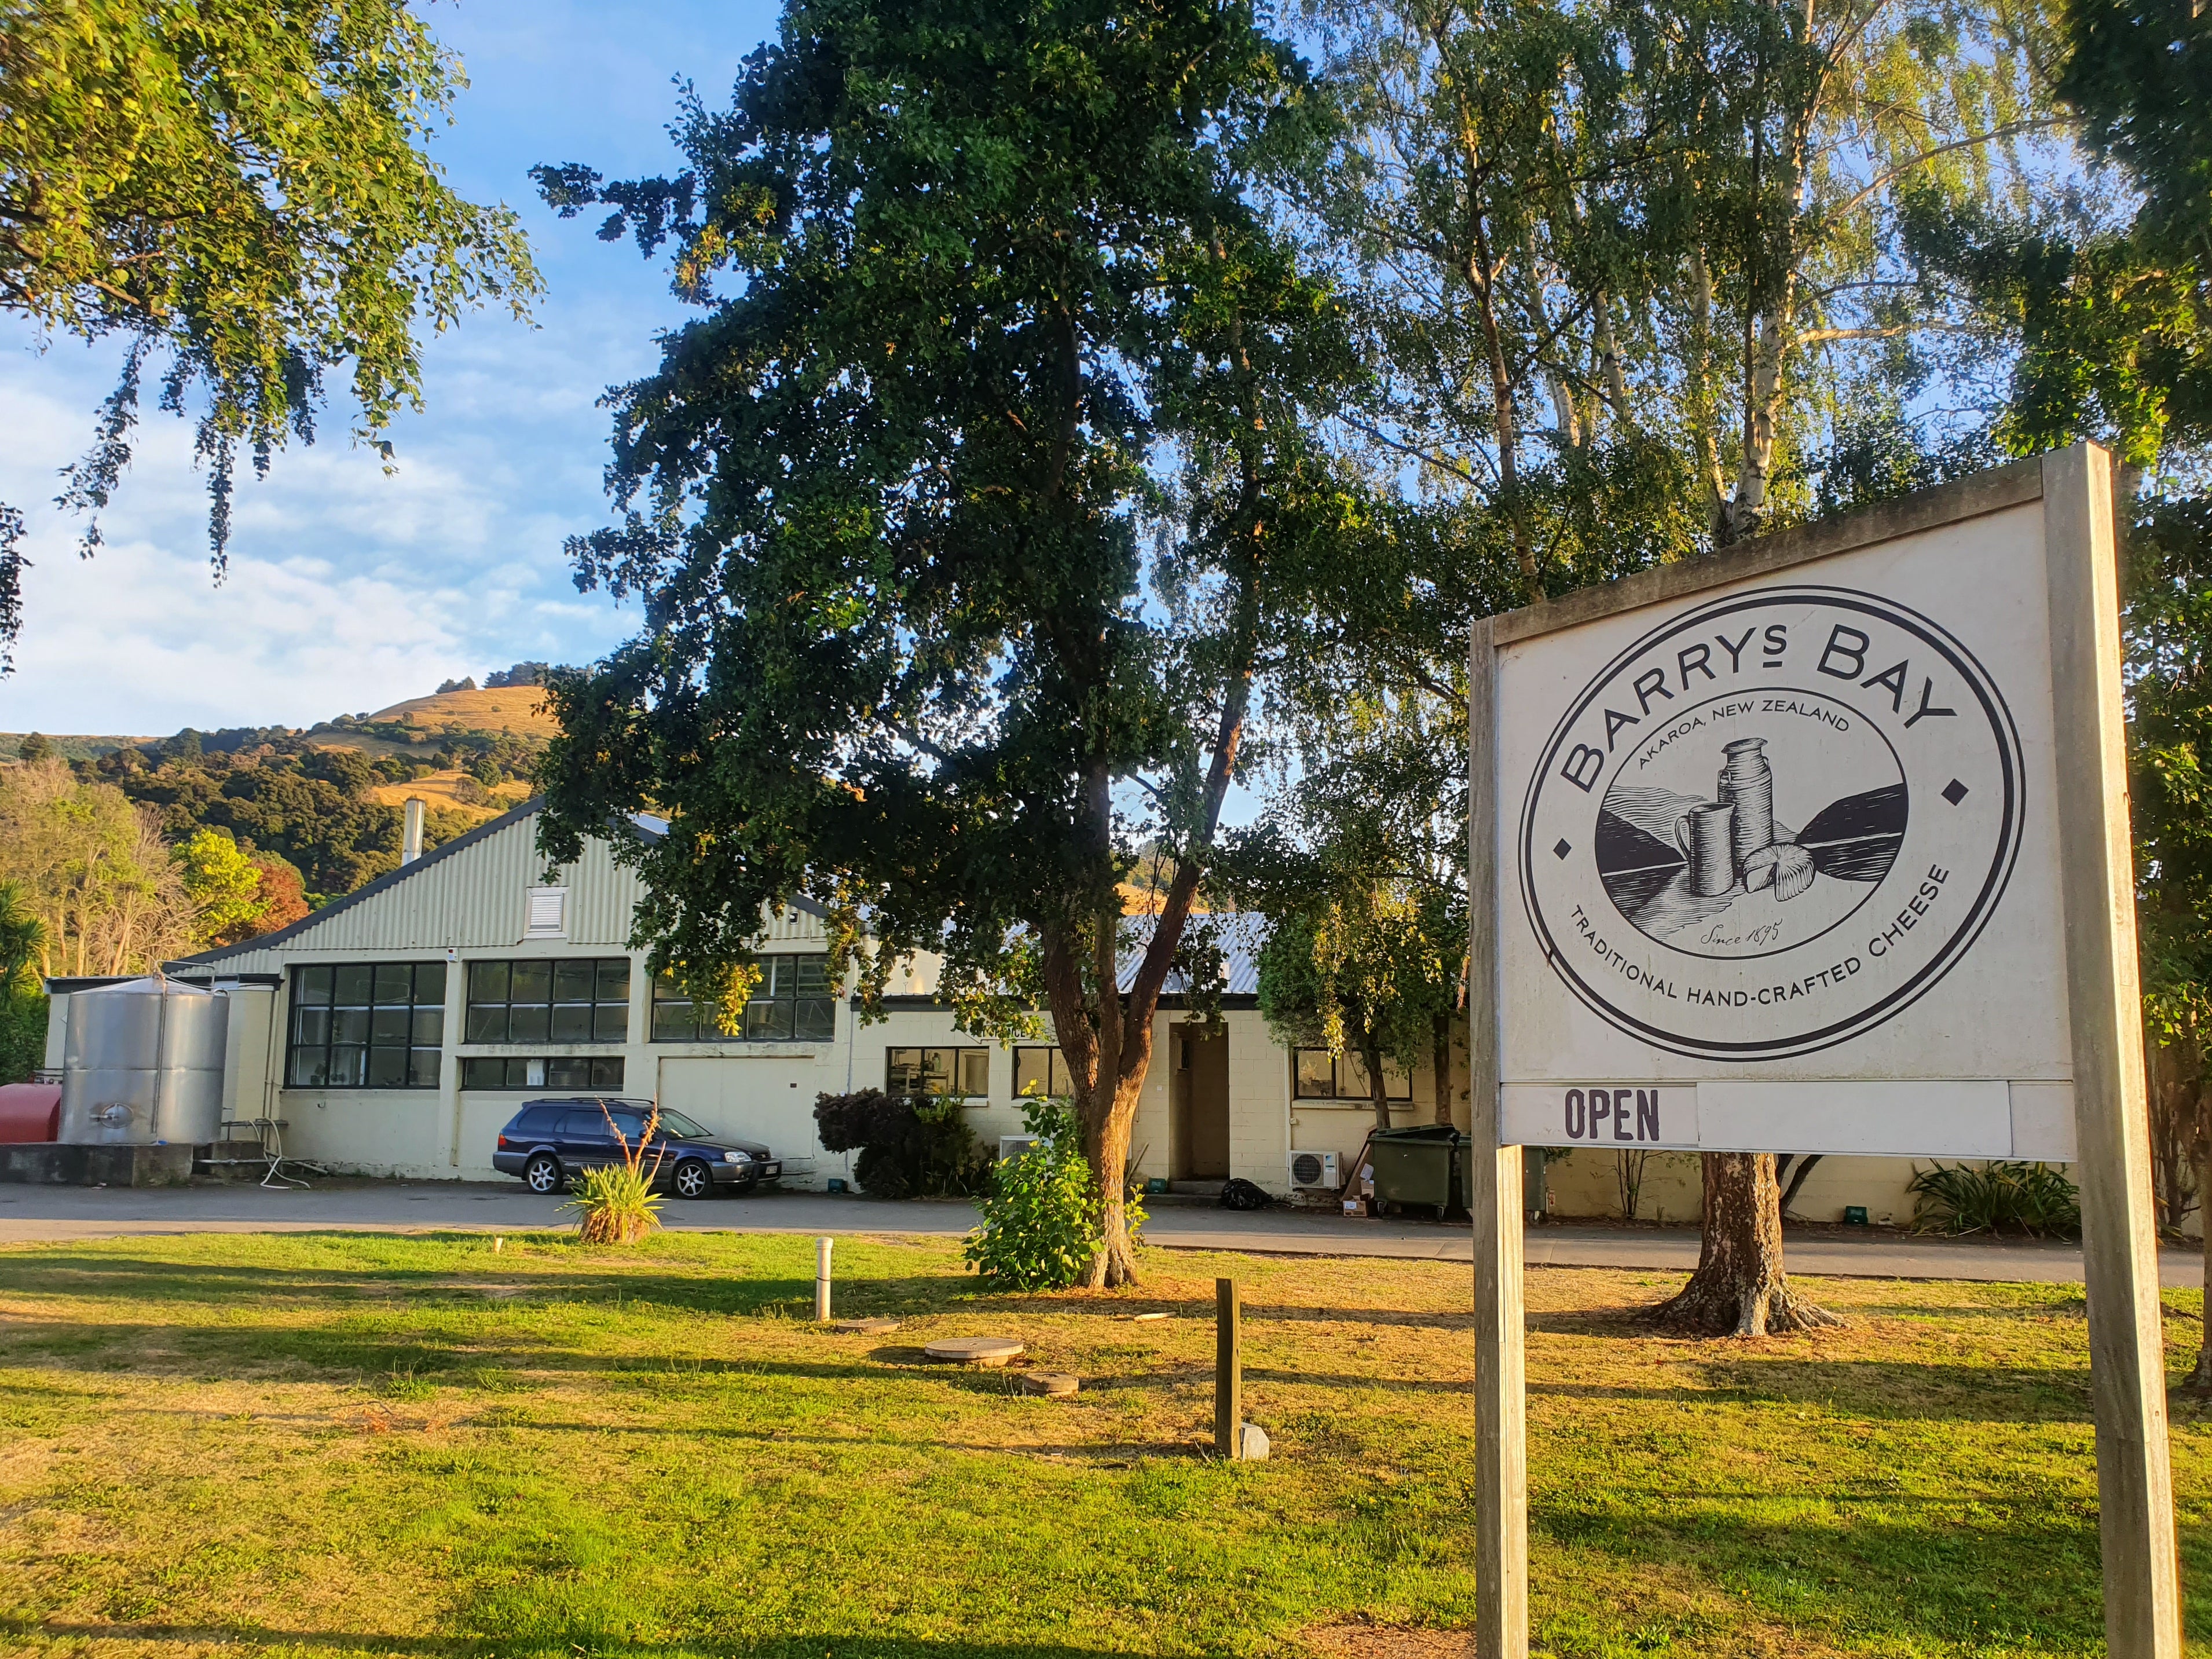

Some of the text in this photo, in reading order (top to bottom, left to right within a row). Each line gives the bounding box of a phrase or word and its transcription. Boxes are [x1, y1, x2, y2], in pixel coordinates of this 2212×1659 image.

[1817, 624, 1958, 730] BAY
[1639, 700, 1850, 770] AKAROA, NEW ZEALAND
[1571, 863, 1950, 1007] TRADITIONAL HAND-CRAFTED CHEESE
[1700, 918, 1783, 946] Since 1895
[1565, 1089, 1660, 1141] OPEN
